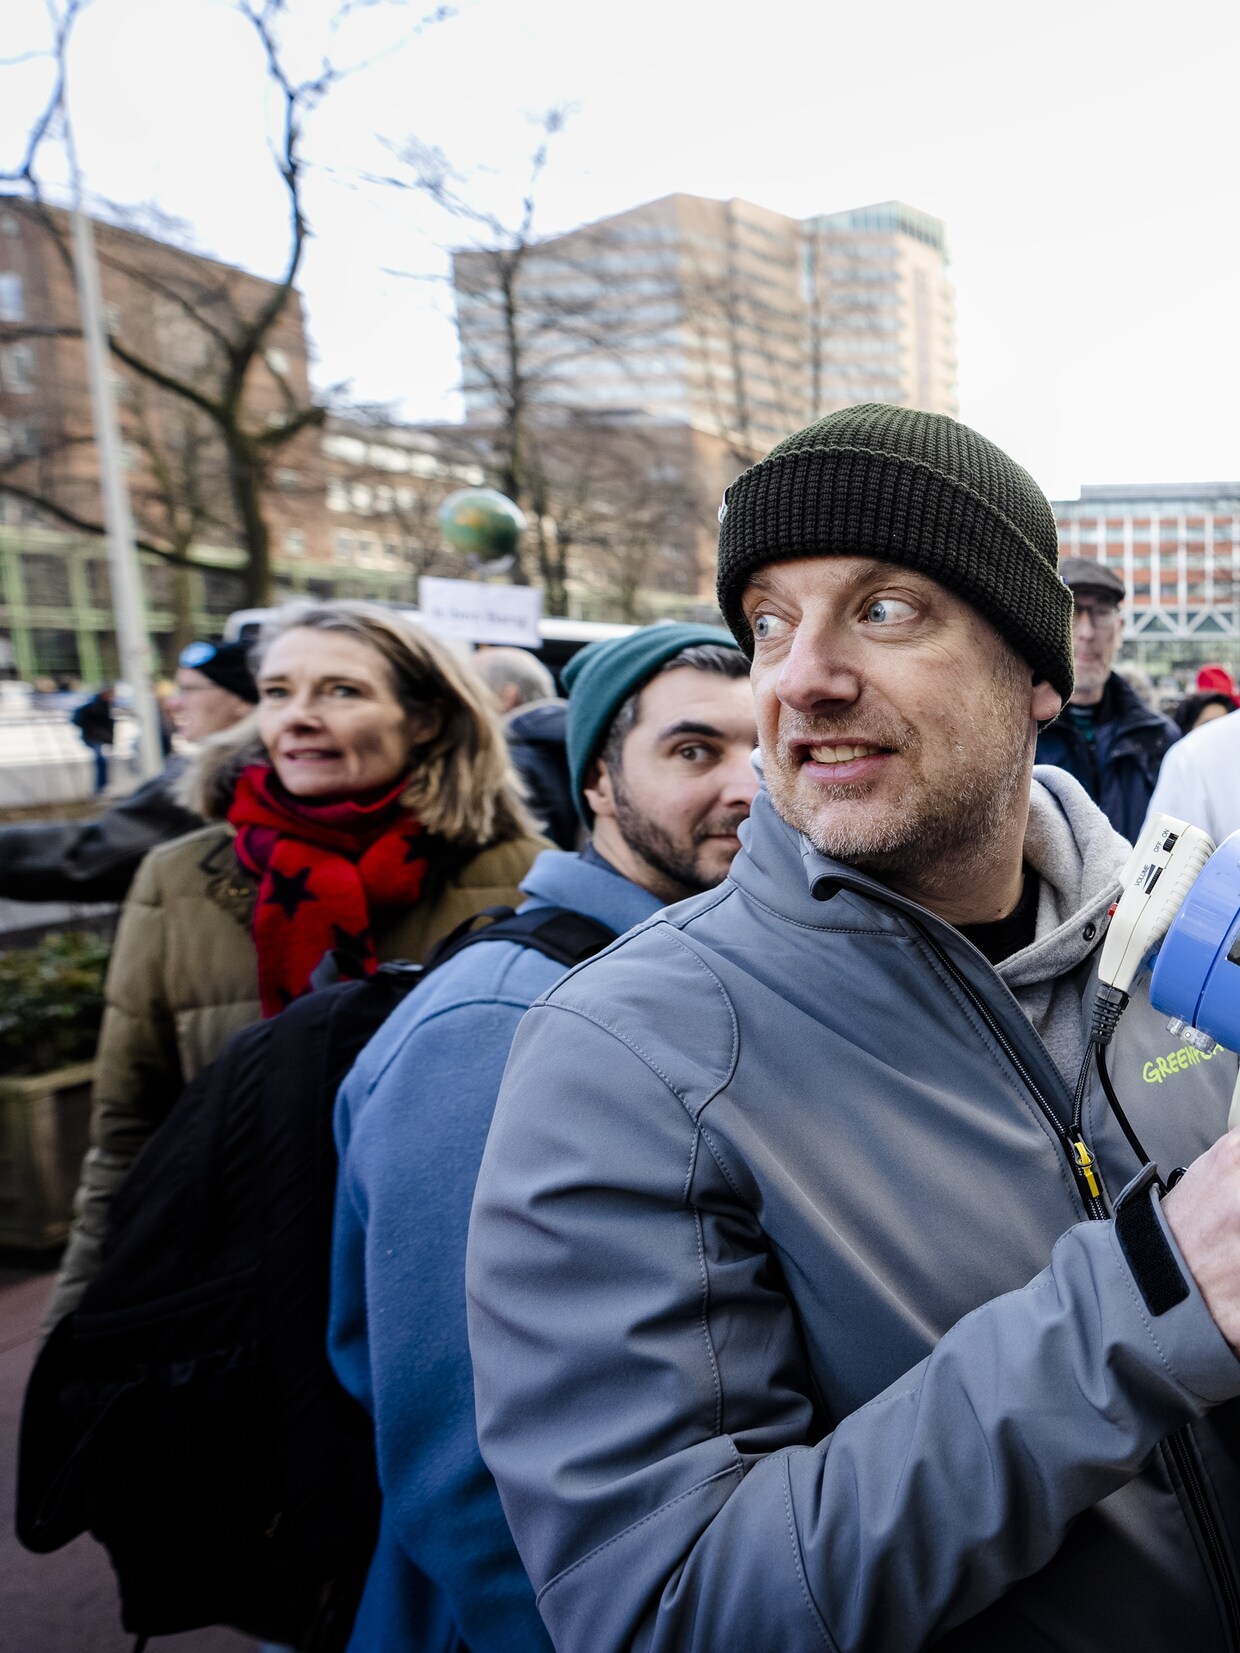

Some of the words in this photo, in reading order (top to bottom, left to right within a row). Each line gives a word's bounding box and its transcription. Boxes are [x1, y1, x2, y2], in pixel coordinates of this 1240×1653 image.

[1153, 841, 1162, 852] OFF
[1162, 829, 1170, 838] ON
[1134, 864, 1150, 886] VOLUME
